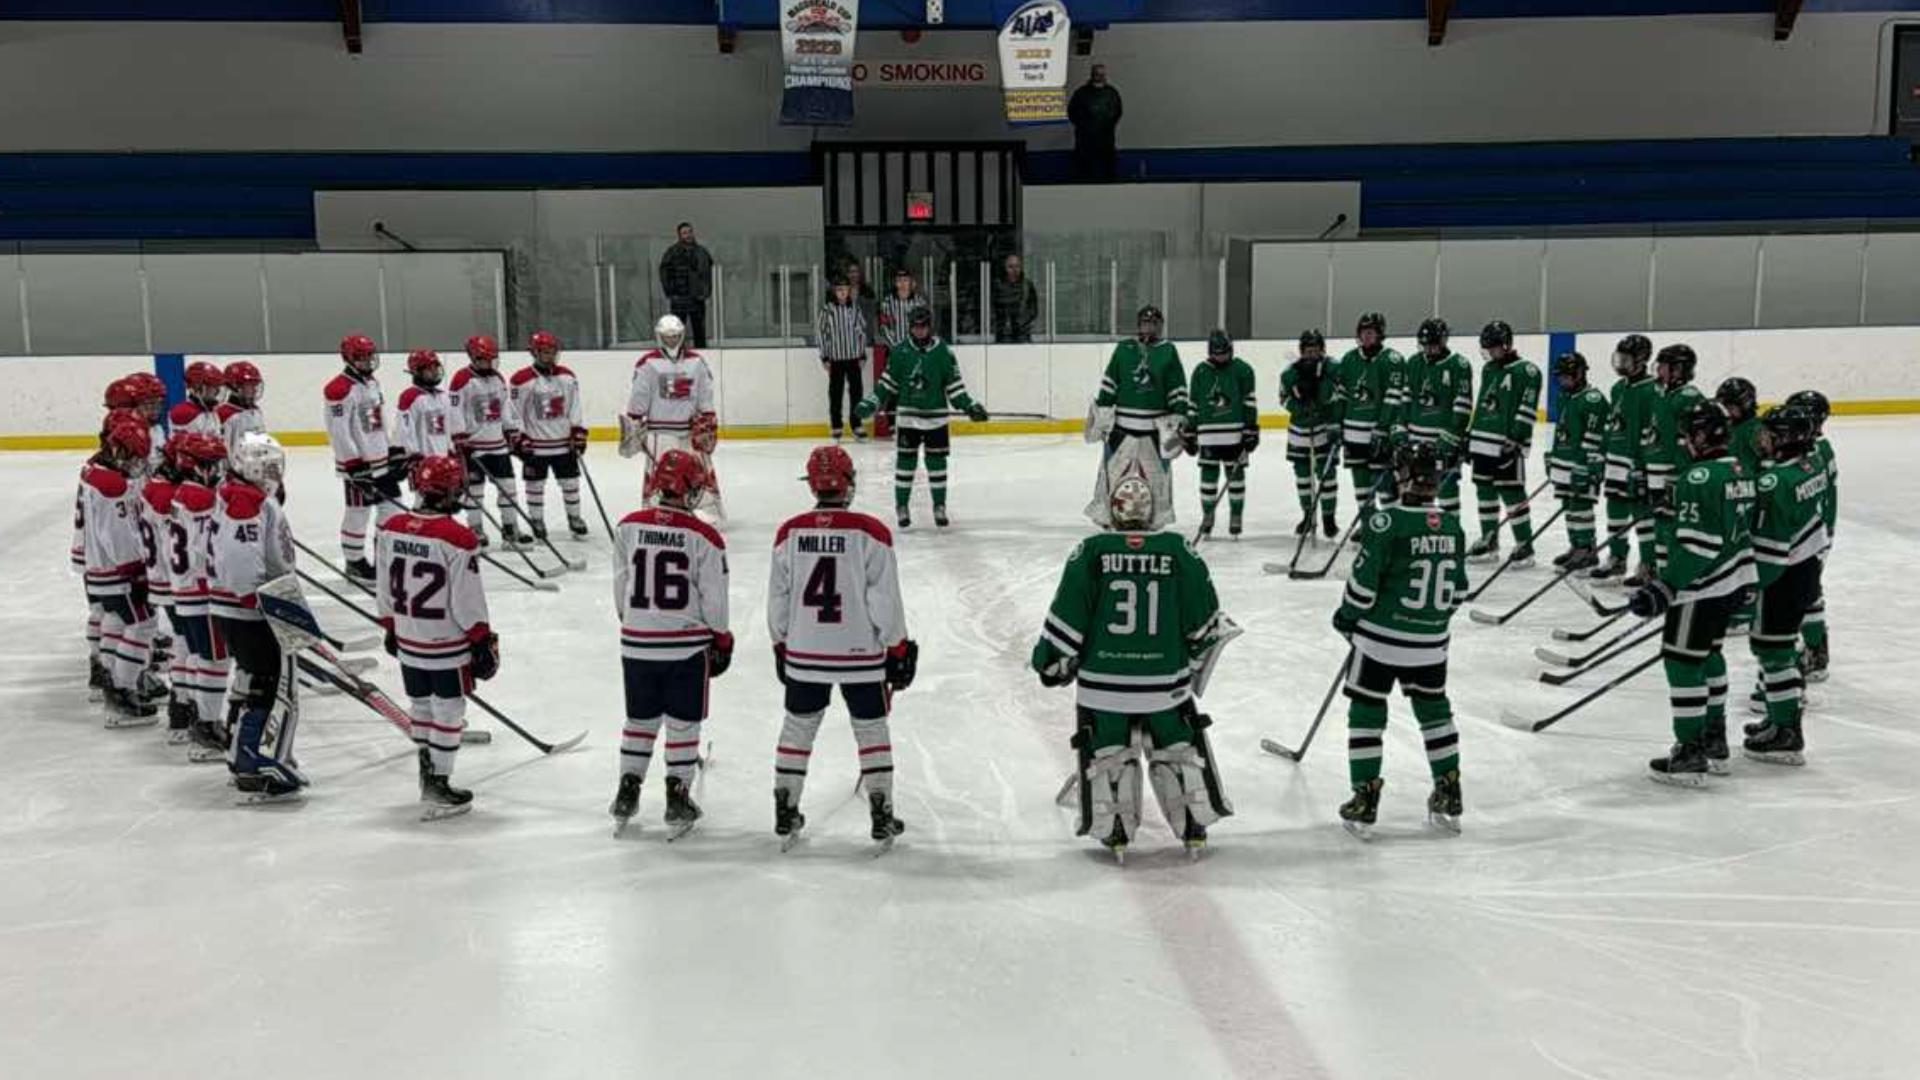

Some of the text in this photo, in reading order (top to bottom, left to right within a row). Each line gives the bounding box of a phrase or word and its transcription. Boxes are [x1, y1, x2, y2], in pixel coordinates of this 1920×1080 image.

[879, 63, 985, 81] SMOKING
[783, 74, 852, 91] CHAMPIONS
[1501, 373, 1513, 391] A
[1679, 502, 1700, 523] 25
[234, 523, 258, 543] 45
[638, 529, 686, 548] THOMAS
[798, 535, 846, 554] MILLER
[1410, 535, 1456, 555] PATON
[389, 556, 447, 620] 42
[629, 548, 690, 611] 16
[802, 555, 842, 624] 4
[1400, 559, 1456, 610] 36
[1106, 580, 1159, 635] 31
